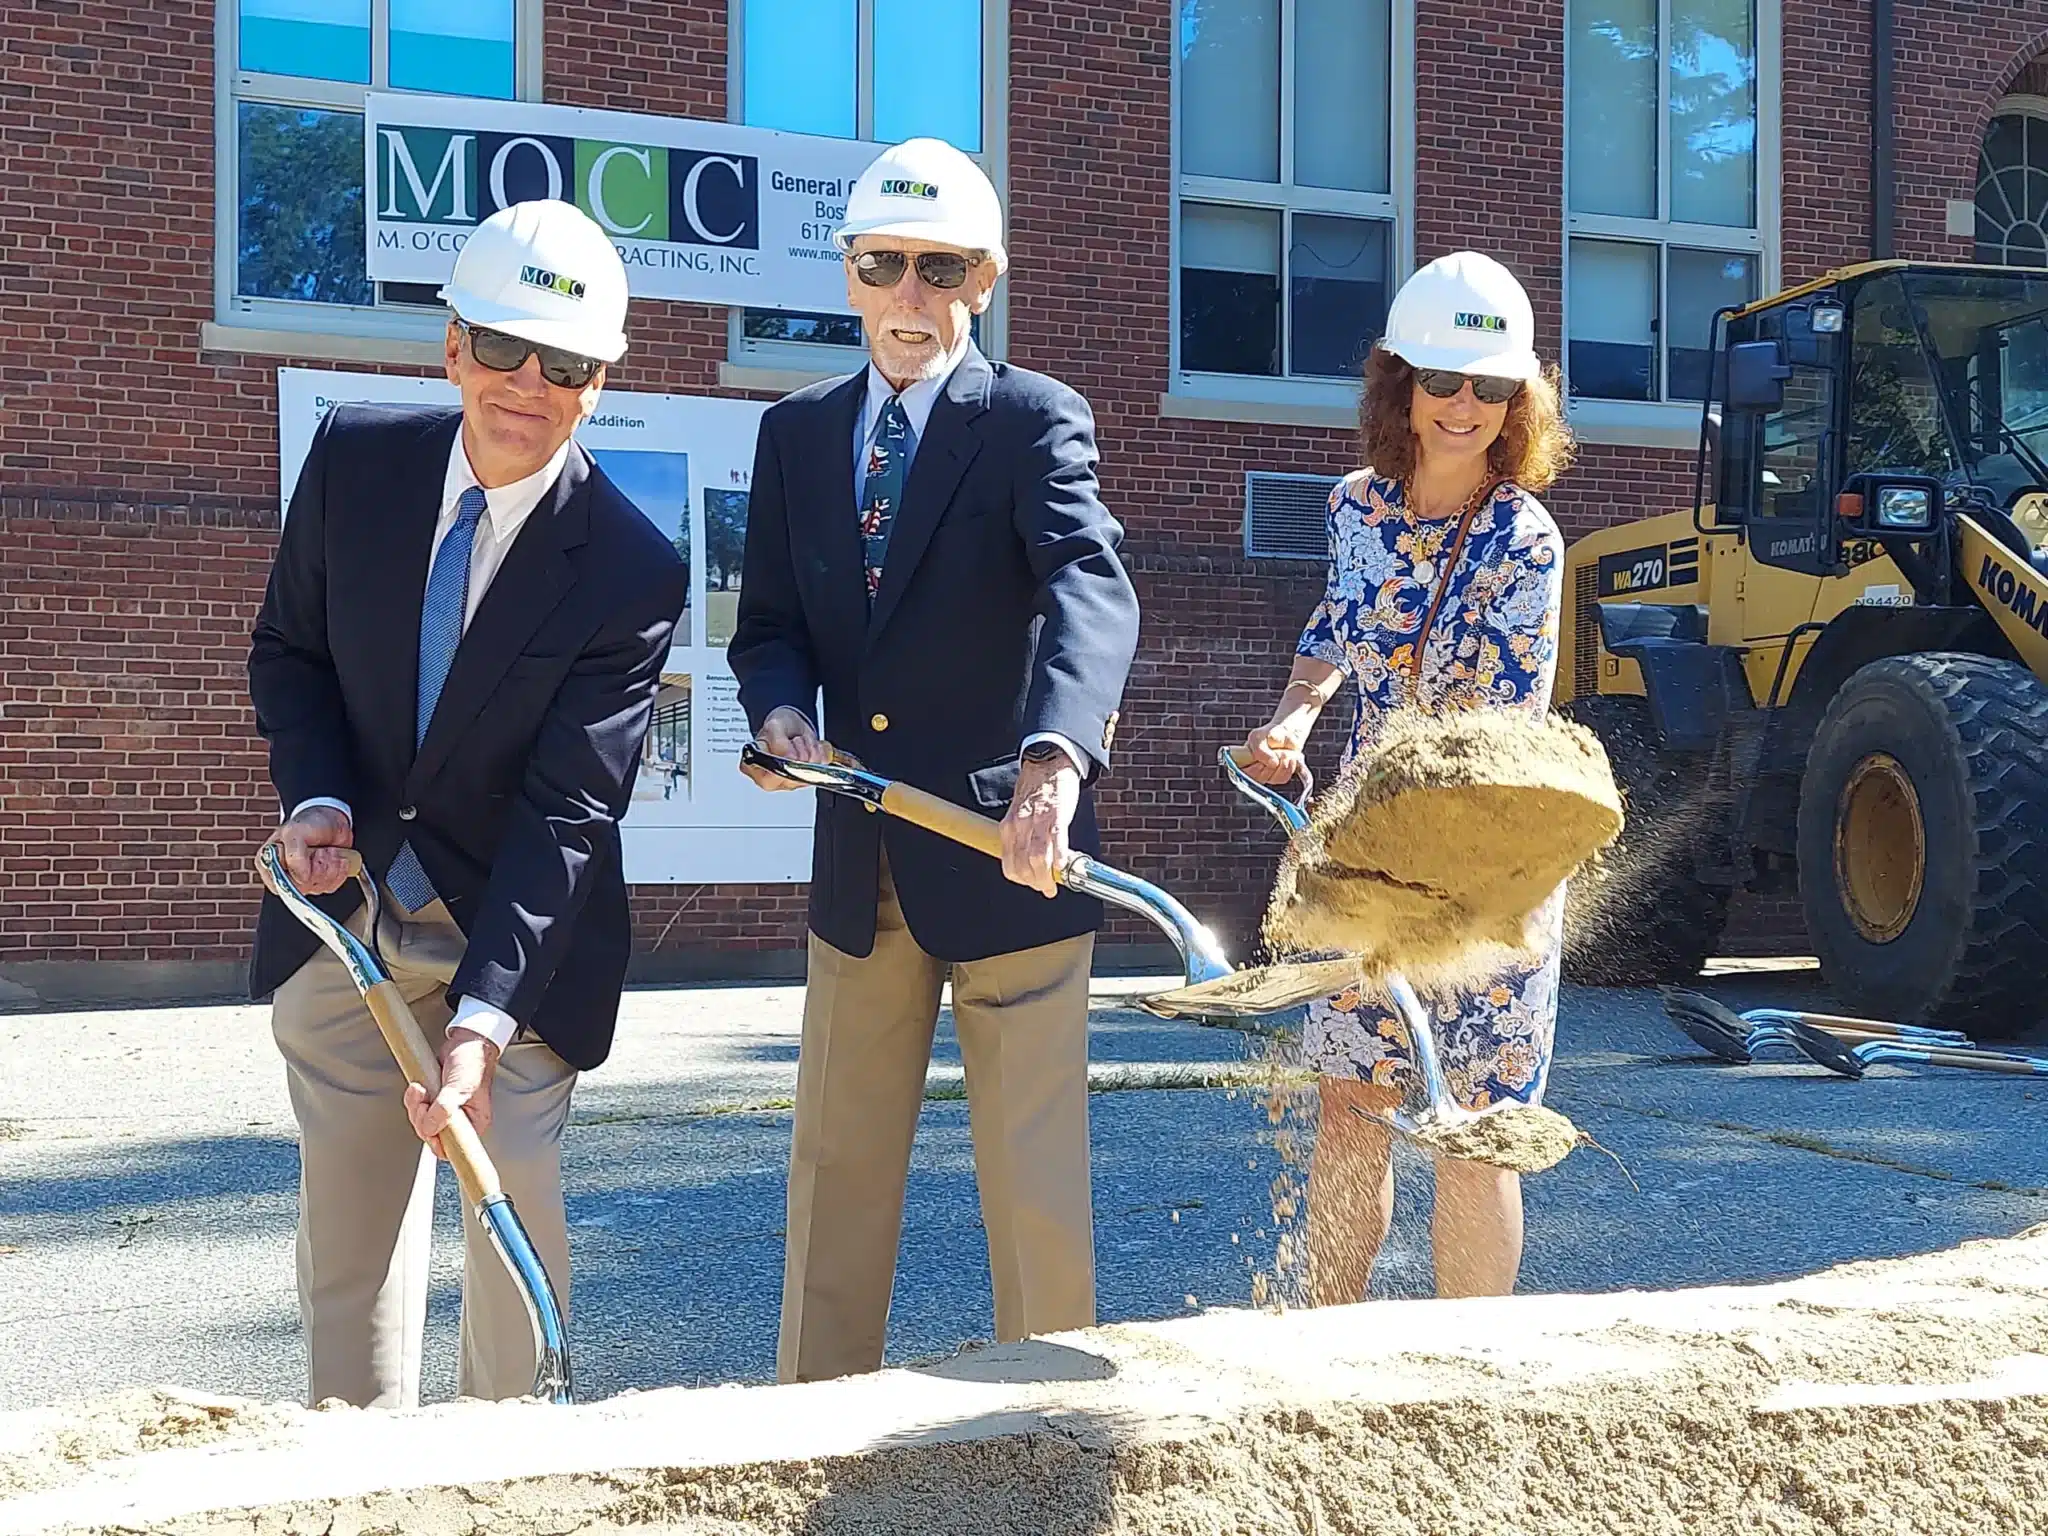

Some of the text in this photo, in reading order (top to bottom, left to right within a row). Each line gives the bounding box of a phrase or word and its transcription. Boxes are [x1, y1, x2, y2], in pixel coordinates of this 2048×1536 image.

[378, 129, 746, 243] MOCC
[771, 170, 842, 197] General
[882, 180, 938, 198] MOCC
[801, 222, 832, 241] 617
[377, 229, 405, 249] M.
[720, 254, 761, 276] INC.
[521, 265, 585, 298] MOCC
[1455, 312, 1507, 331] MOCC
[588, 414, 646, 428] Addition
[1613, 558, 1663, 591] WA270
